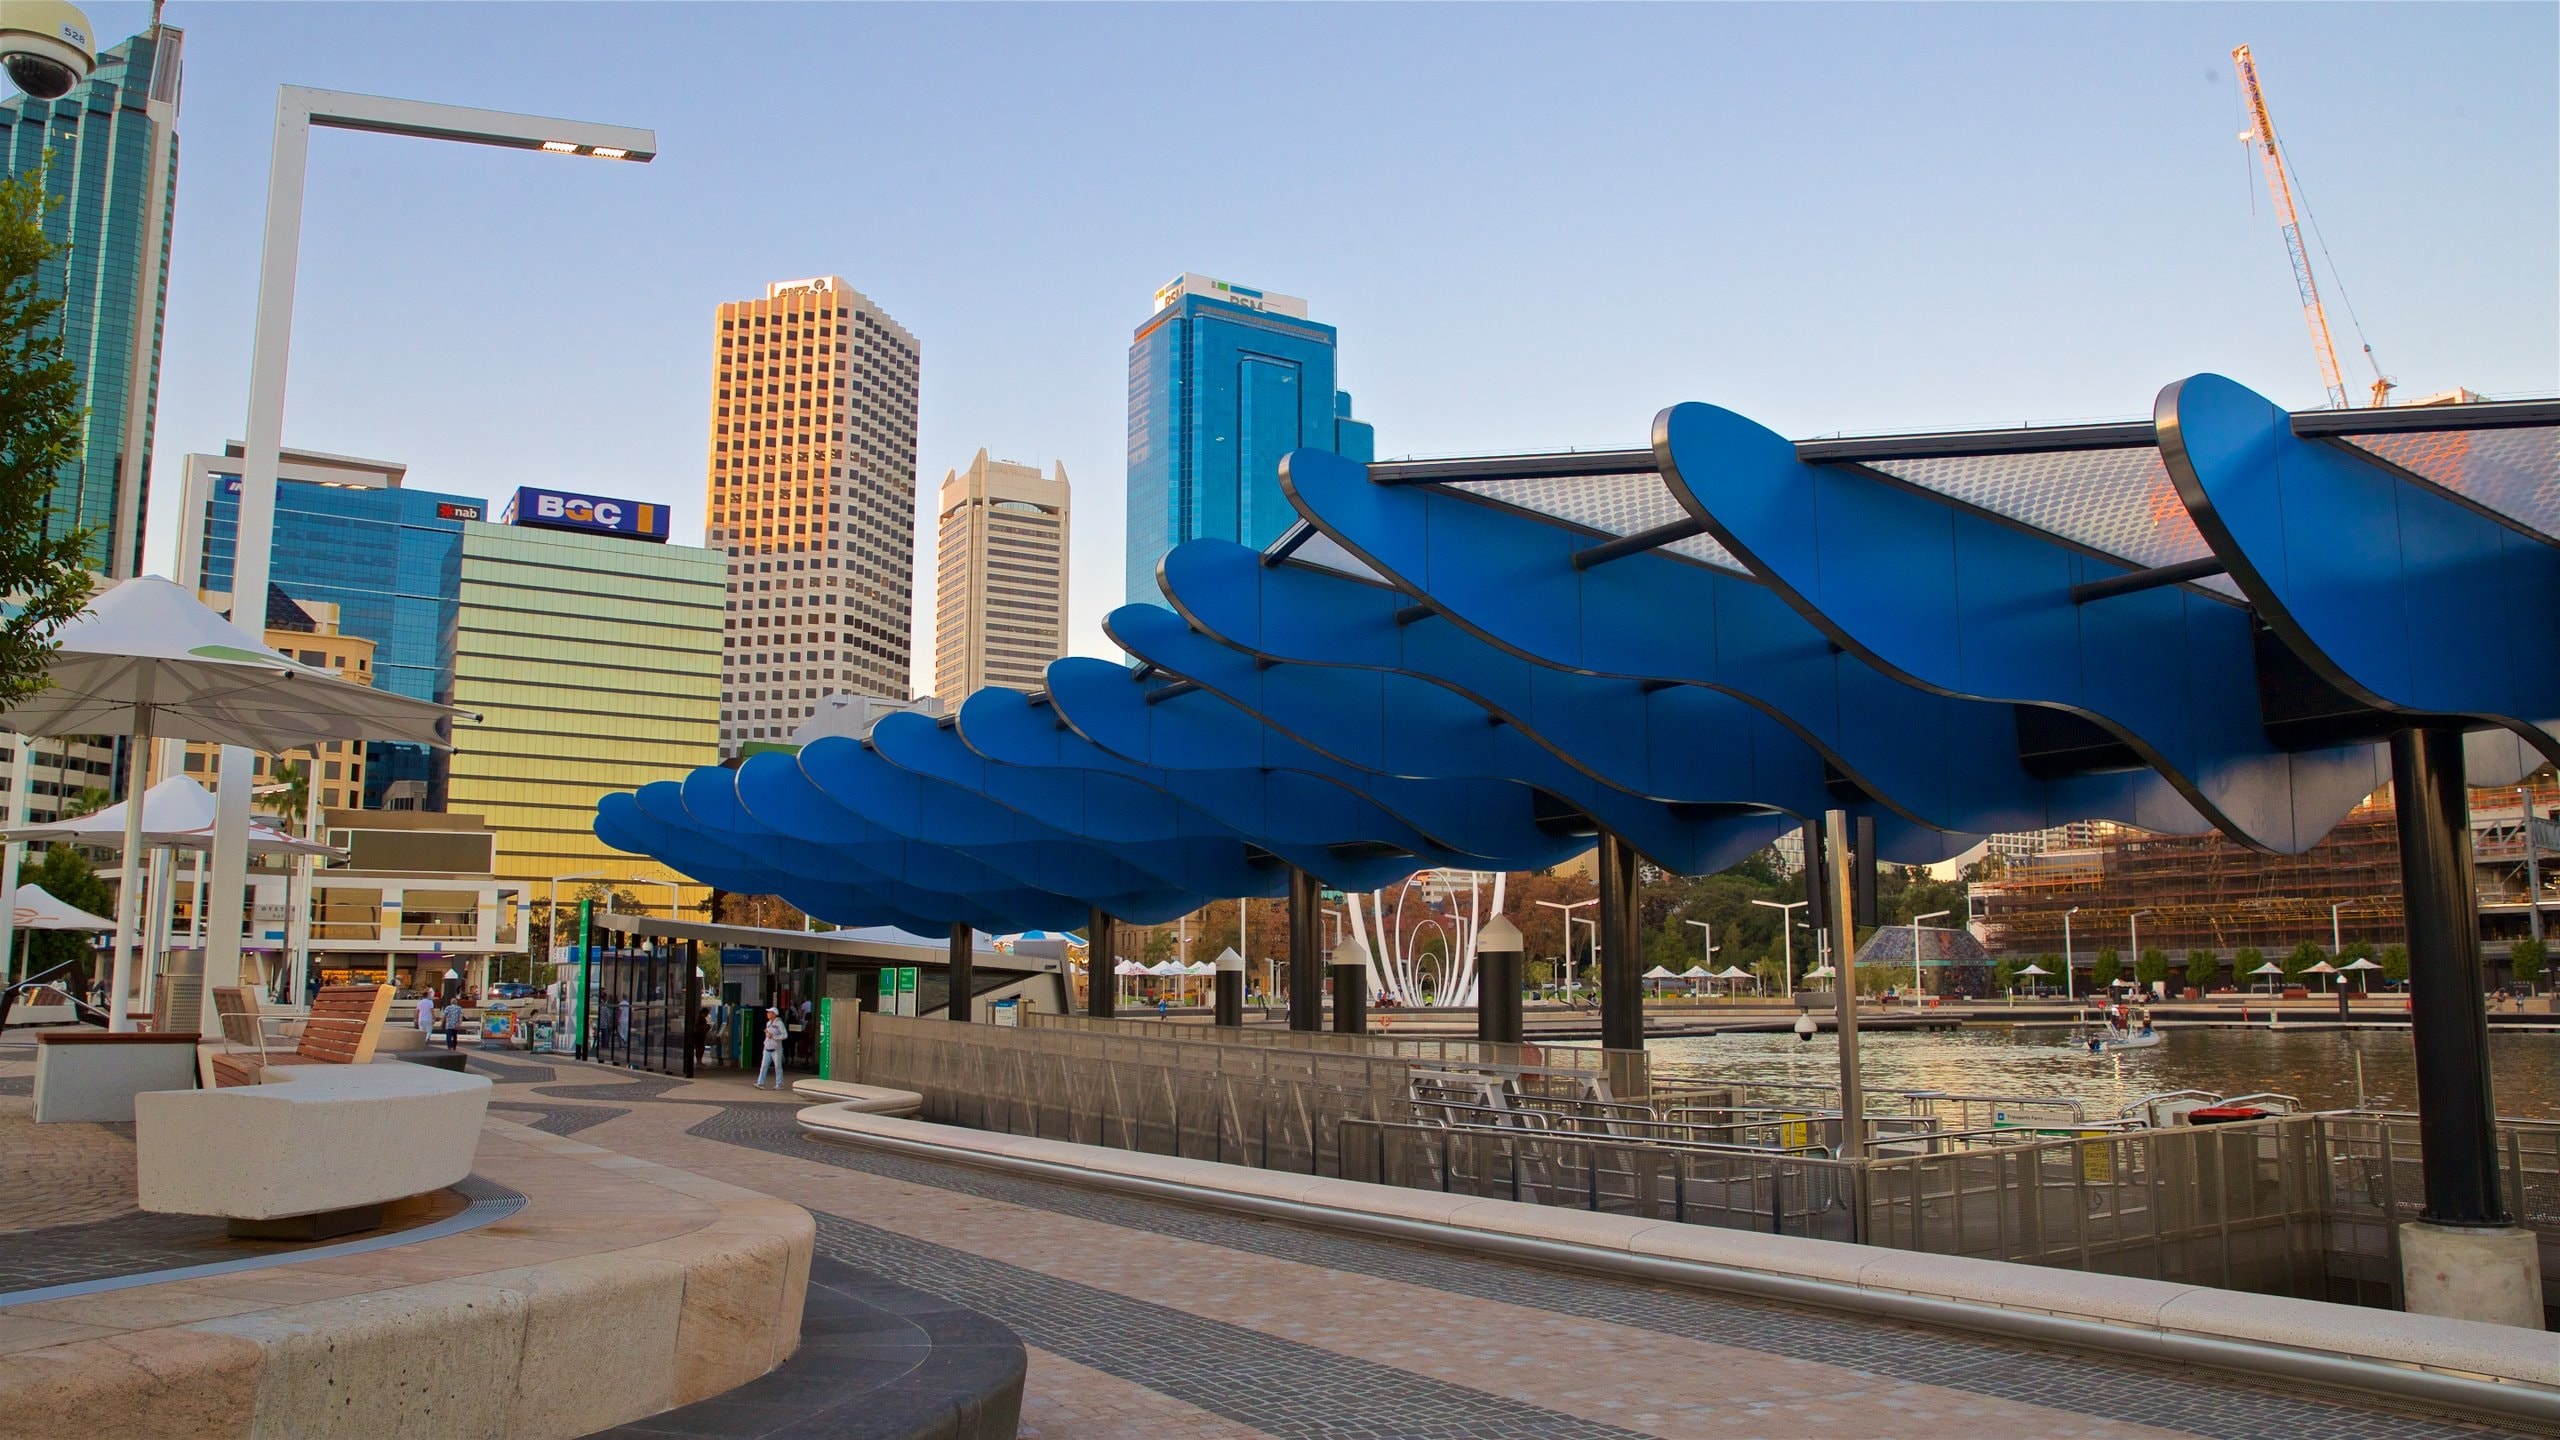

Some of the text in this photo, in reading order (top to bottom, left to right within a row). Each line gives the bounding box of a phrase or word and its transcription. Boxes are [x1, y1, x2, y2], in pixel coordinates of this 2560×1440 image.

[64, 26, 85, 45] 528
[454, 507, 478, 519] nab
[538, 494, 622, 526] BGC
